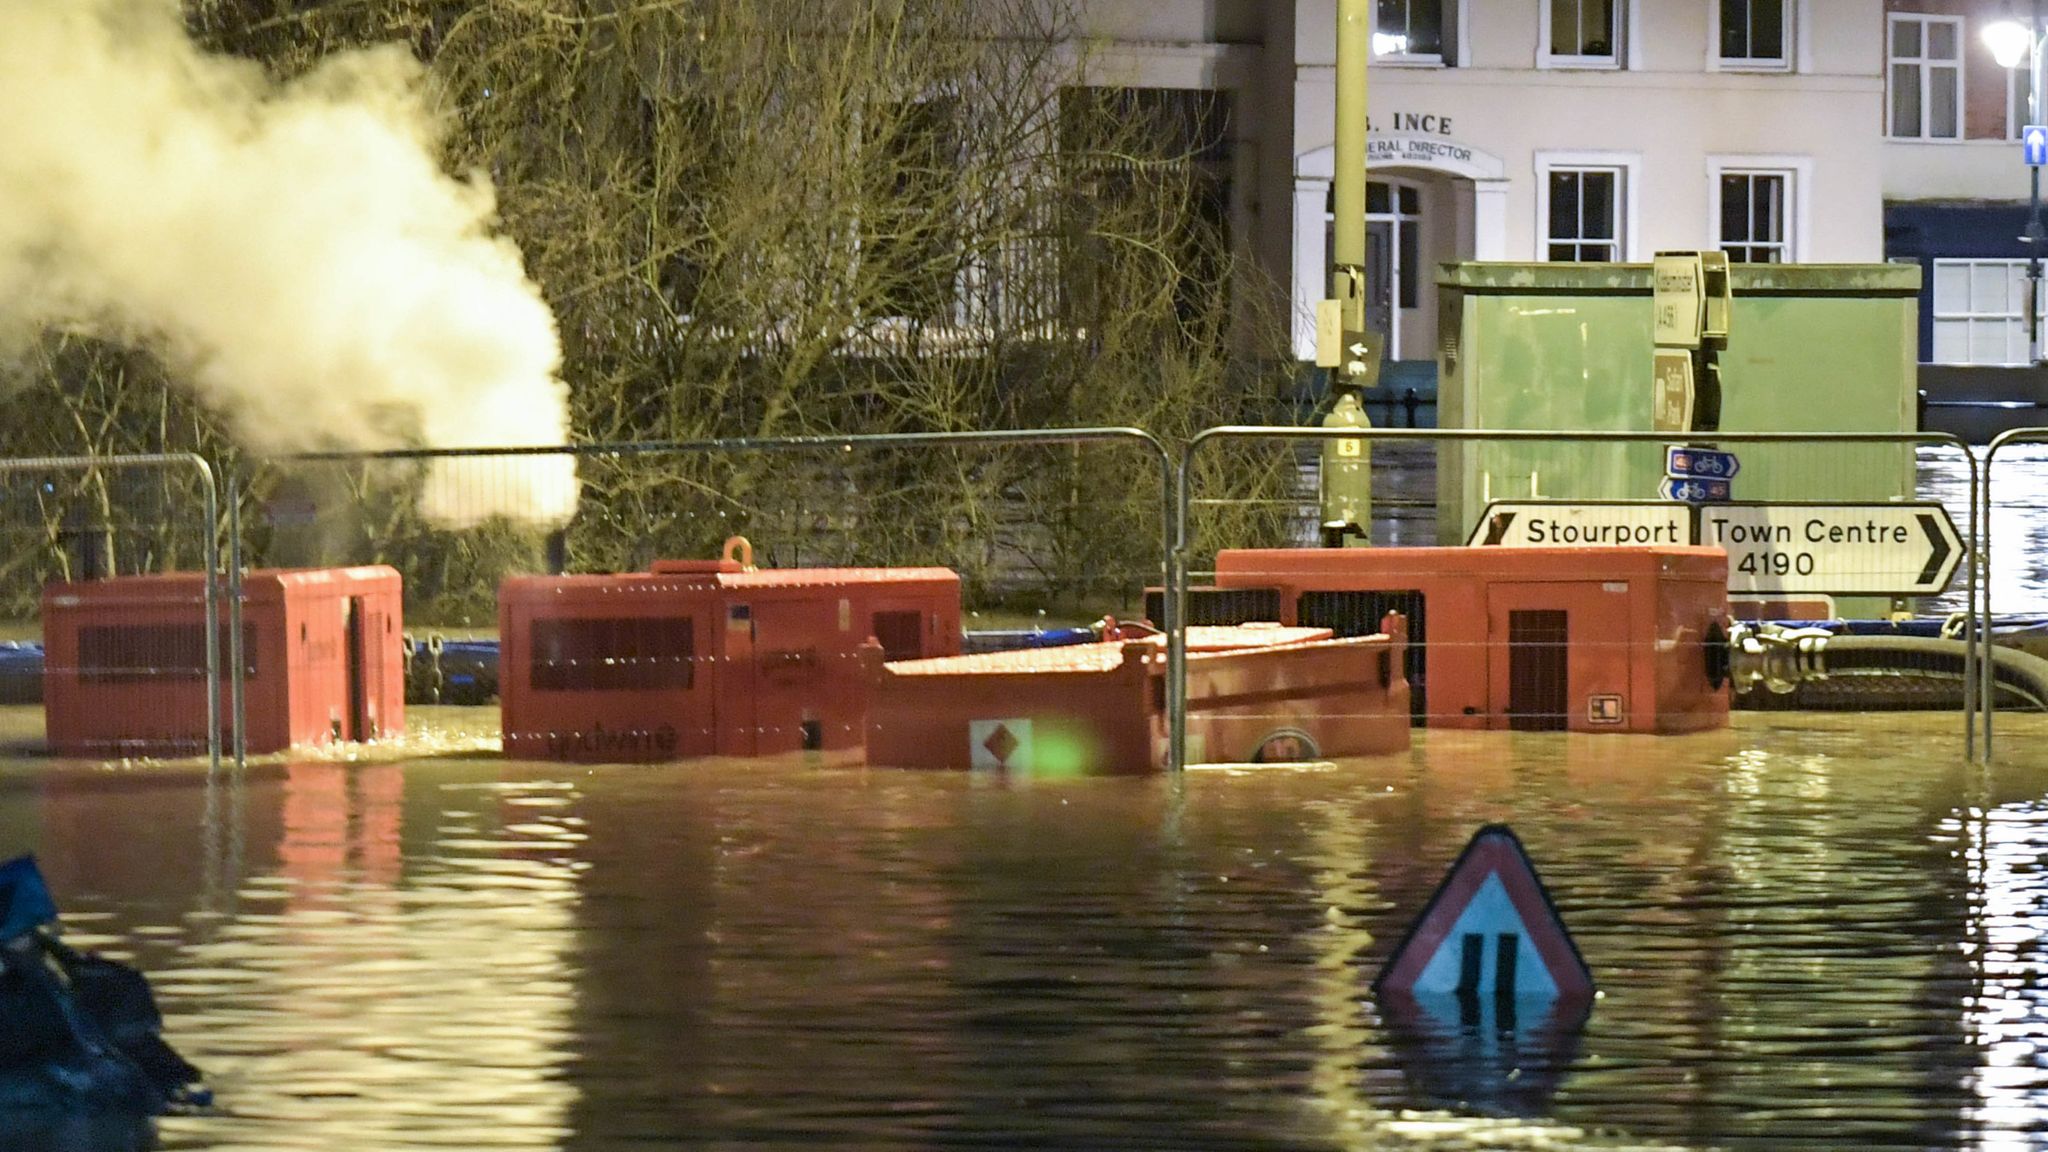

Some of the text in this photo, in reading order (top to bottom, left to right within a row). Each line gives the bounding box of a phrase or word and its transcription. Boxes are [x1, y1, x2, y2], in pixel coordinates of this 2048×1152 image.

[1393, 112, 1452, 135] INCE
[1366, 140, 1402, 153] ERAL
[1409, 140, 1471, 161] DIRECTOR
[1527, 519, 1679, 546] Stourport
[1712, 518, 1908, 543] Town Centre
[1737, 552, 1814, 576] 4190
